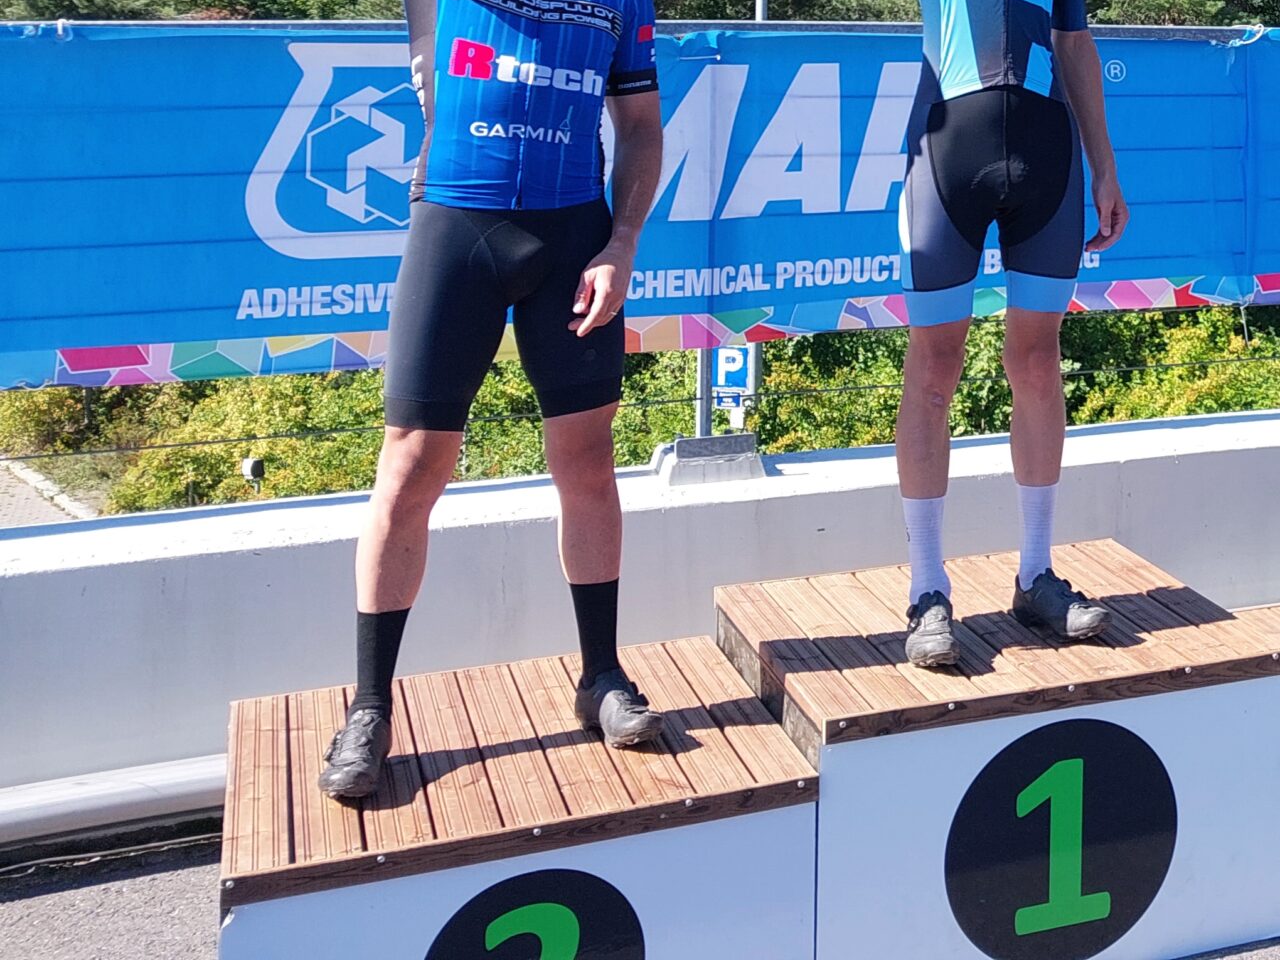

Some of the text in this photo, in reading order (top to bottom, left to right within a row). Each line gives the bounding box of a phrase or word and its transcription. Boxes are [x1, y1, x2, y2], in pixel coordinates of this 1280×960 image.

[562, 12, 613, 31] POWER
[594, 7, 615, 20] OY
[469, 121, 572, 144] GARMIN
[626, 263, 772, 301] CHEMICAL
[775, 253, 902, 290] PRODUCT
[717, 347, 744, 386] P
[1014, 757, 1112, 936] 1
